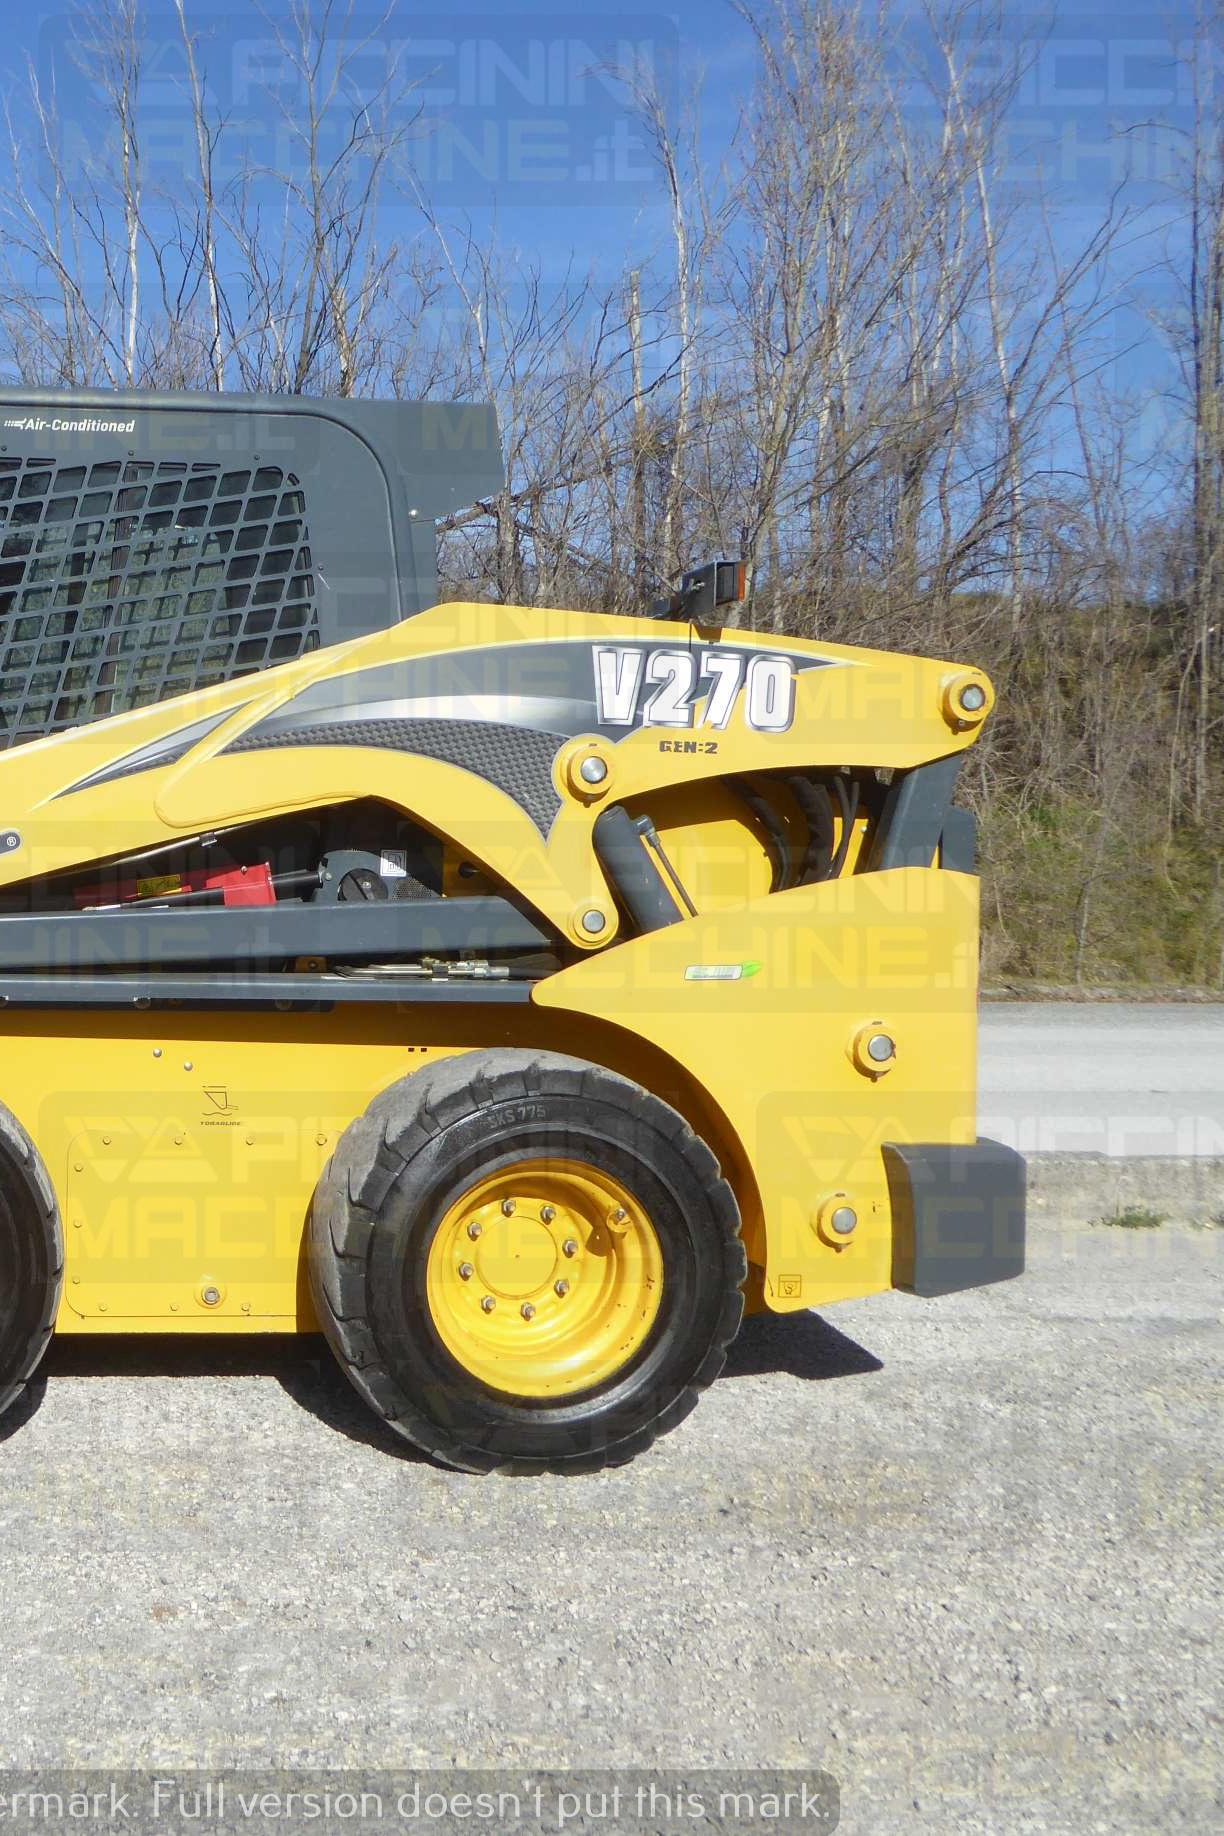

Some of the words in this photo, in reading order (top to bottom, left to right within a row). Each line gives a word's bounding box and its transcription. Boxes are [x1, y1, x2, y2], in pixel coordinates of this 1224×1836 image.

[24, 417, 136, 433] Air-Conditioned
[591, 645, 798, 733] V270
[659, 740, 718, 755] GEN:2
